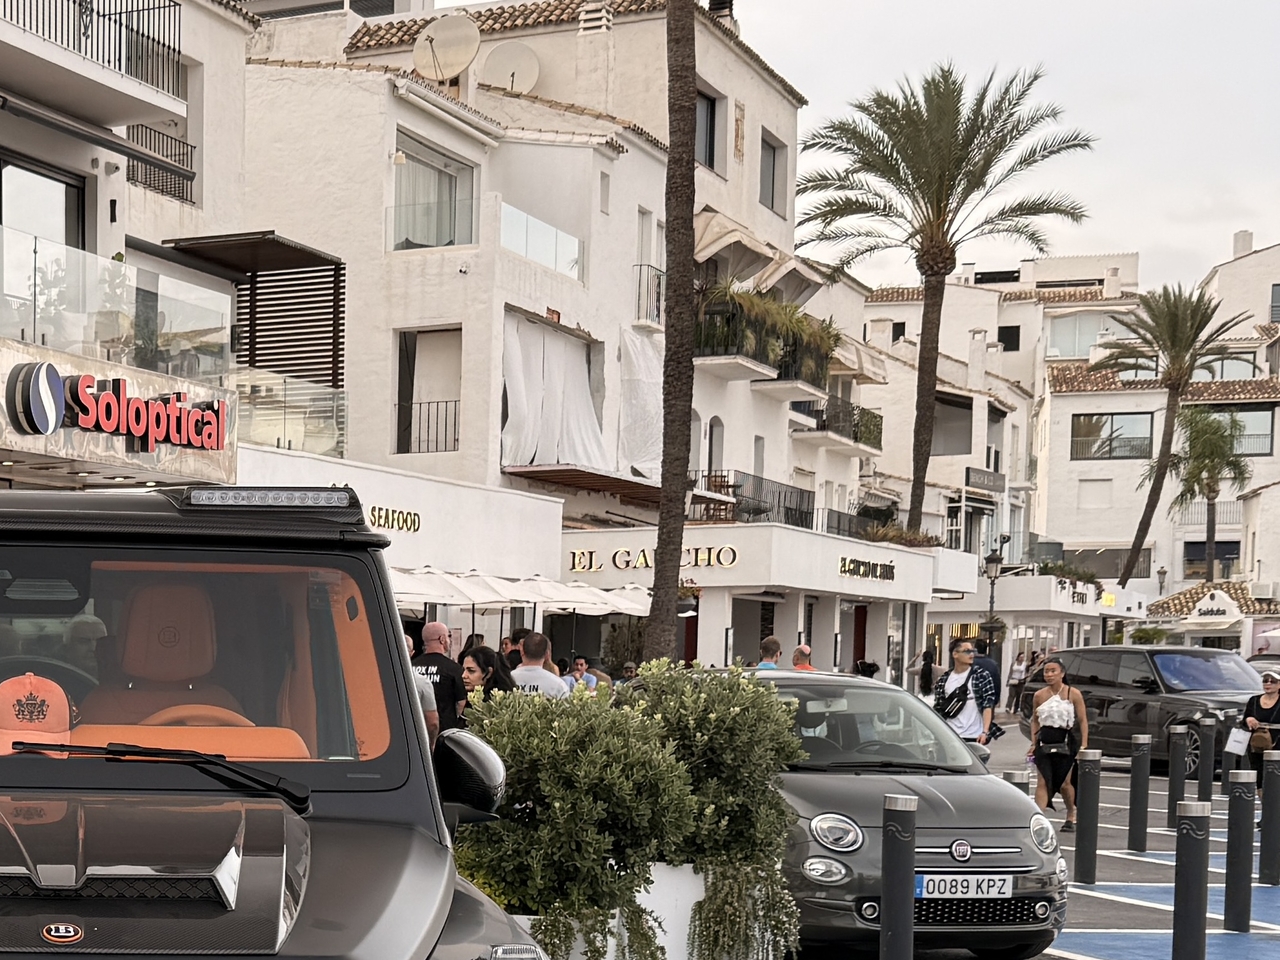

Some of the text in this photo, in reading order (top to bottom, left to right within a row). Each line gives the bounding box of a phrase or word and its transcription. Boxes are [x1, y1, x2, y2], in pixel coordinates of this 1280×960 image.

[78, 374, 226, 453] Soloptical
[369, 506, 420, 533] SEAFOOD
[570, 544, 738, 572] EL GACHO
[427, 665, 438, 674] IN
[926, 878, 970, 895] 0089
[975, 878, 1007, 895] KPZ
